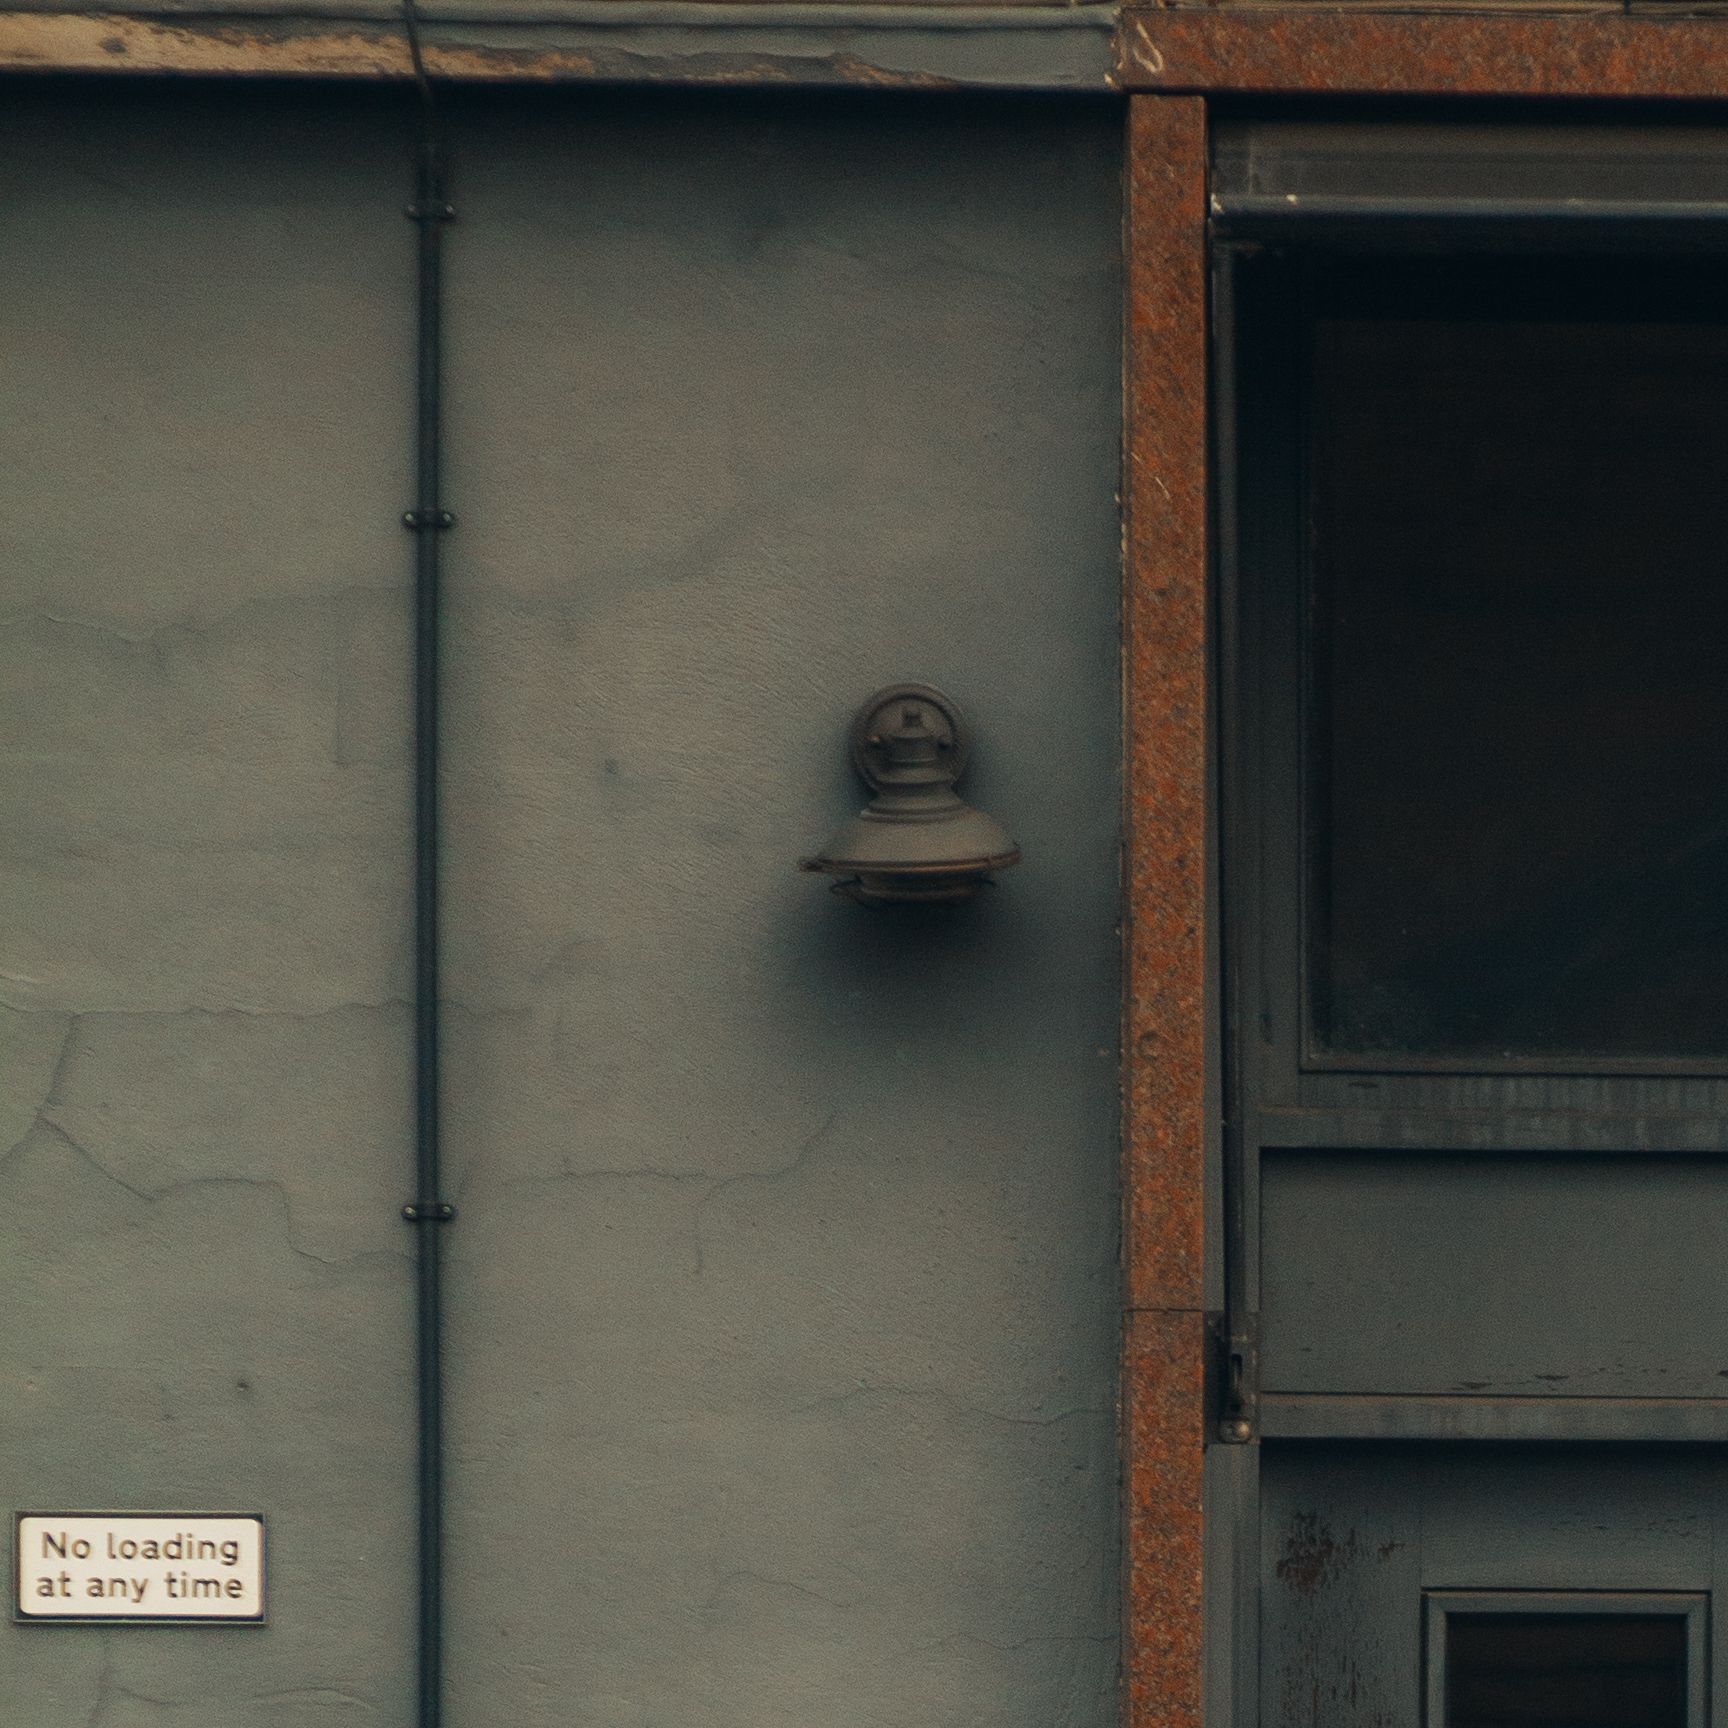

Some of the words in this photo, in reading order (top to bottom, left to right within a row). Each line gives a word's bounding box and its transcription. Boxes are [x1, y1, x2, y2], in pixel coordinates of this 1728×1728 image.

[41, 1531, 91, 1560] No
[107, 1532, 239, 1567] loading
[36, 1571, 72, 1598] at
[86, 1577, 149, 1604] any
[164, 1571, 243, 1599] time
